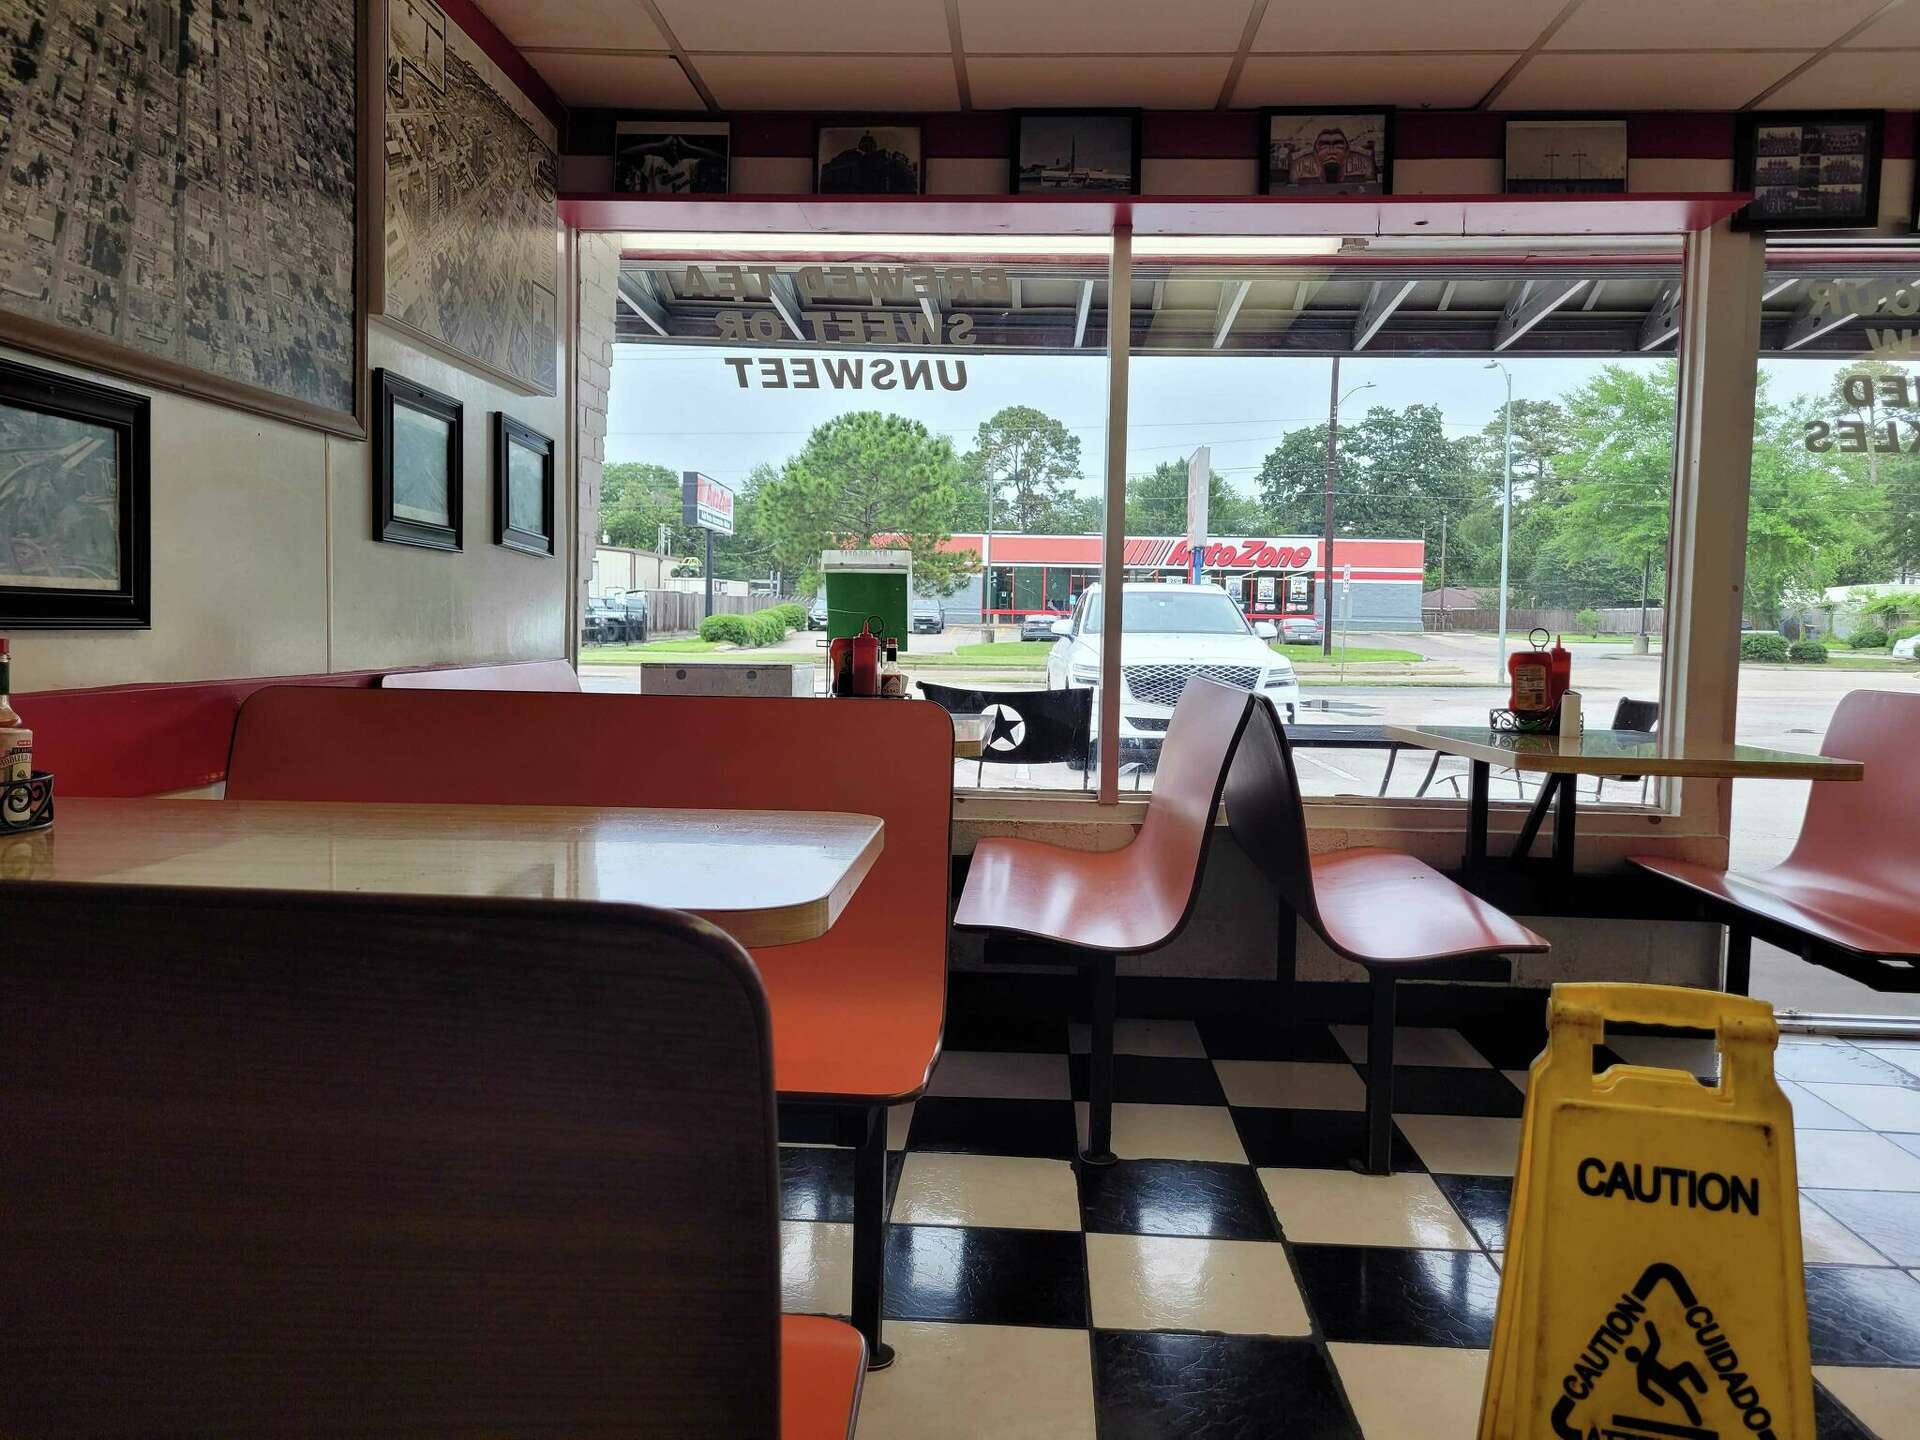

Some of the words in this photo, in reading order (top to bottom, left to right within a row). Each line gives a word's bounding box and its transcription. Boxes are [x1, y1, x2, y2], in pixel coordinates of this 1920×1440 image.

[1166, 540, 1312, 568] AtoZone
[1577, 1157, 1759, 1215] CAUTION
[1563, 1293, 1647, 1400] CAUTION
[1685, 1305, 1772, 1432] CUIDADO
